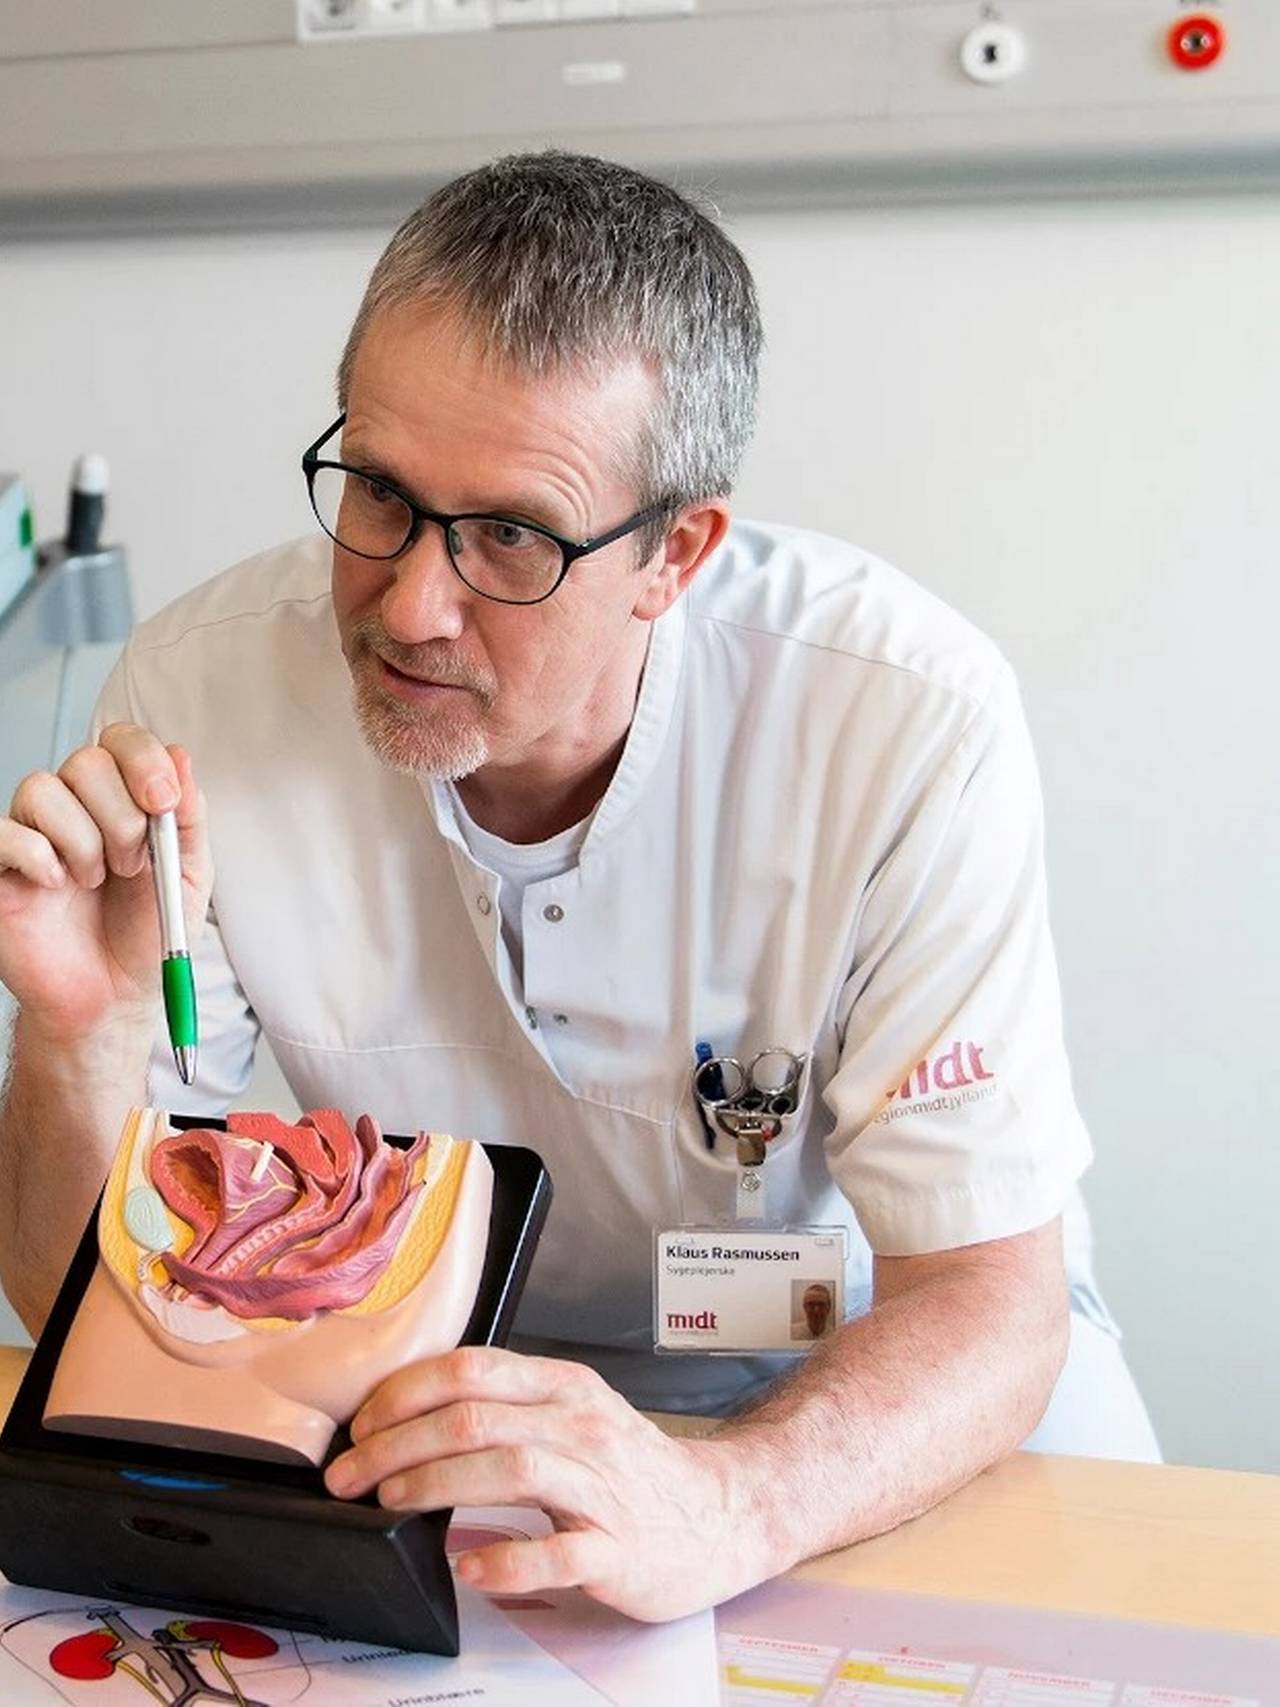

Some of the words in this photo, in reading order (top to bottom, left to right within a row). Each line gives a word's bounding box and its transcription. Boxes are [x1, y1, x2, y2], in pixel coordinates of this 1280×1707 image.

[666, 1245, 709, 1259] Klaus
[711, 1246, 800, 1261] Rasmussen
[666, 1311, 718, 1330] midt
